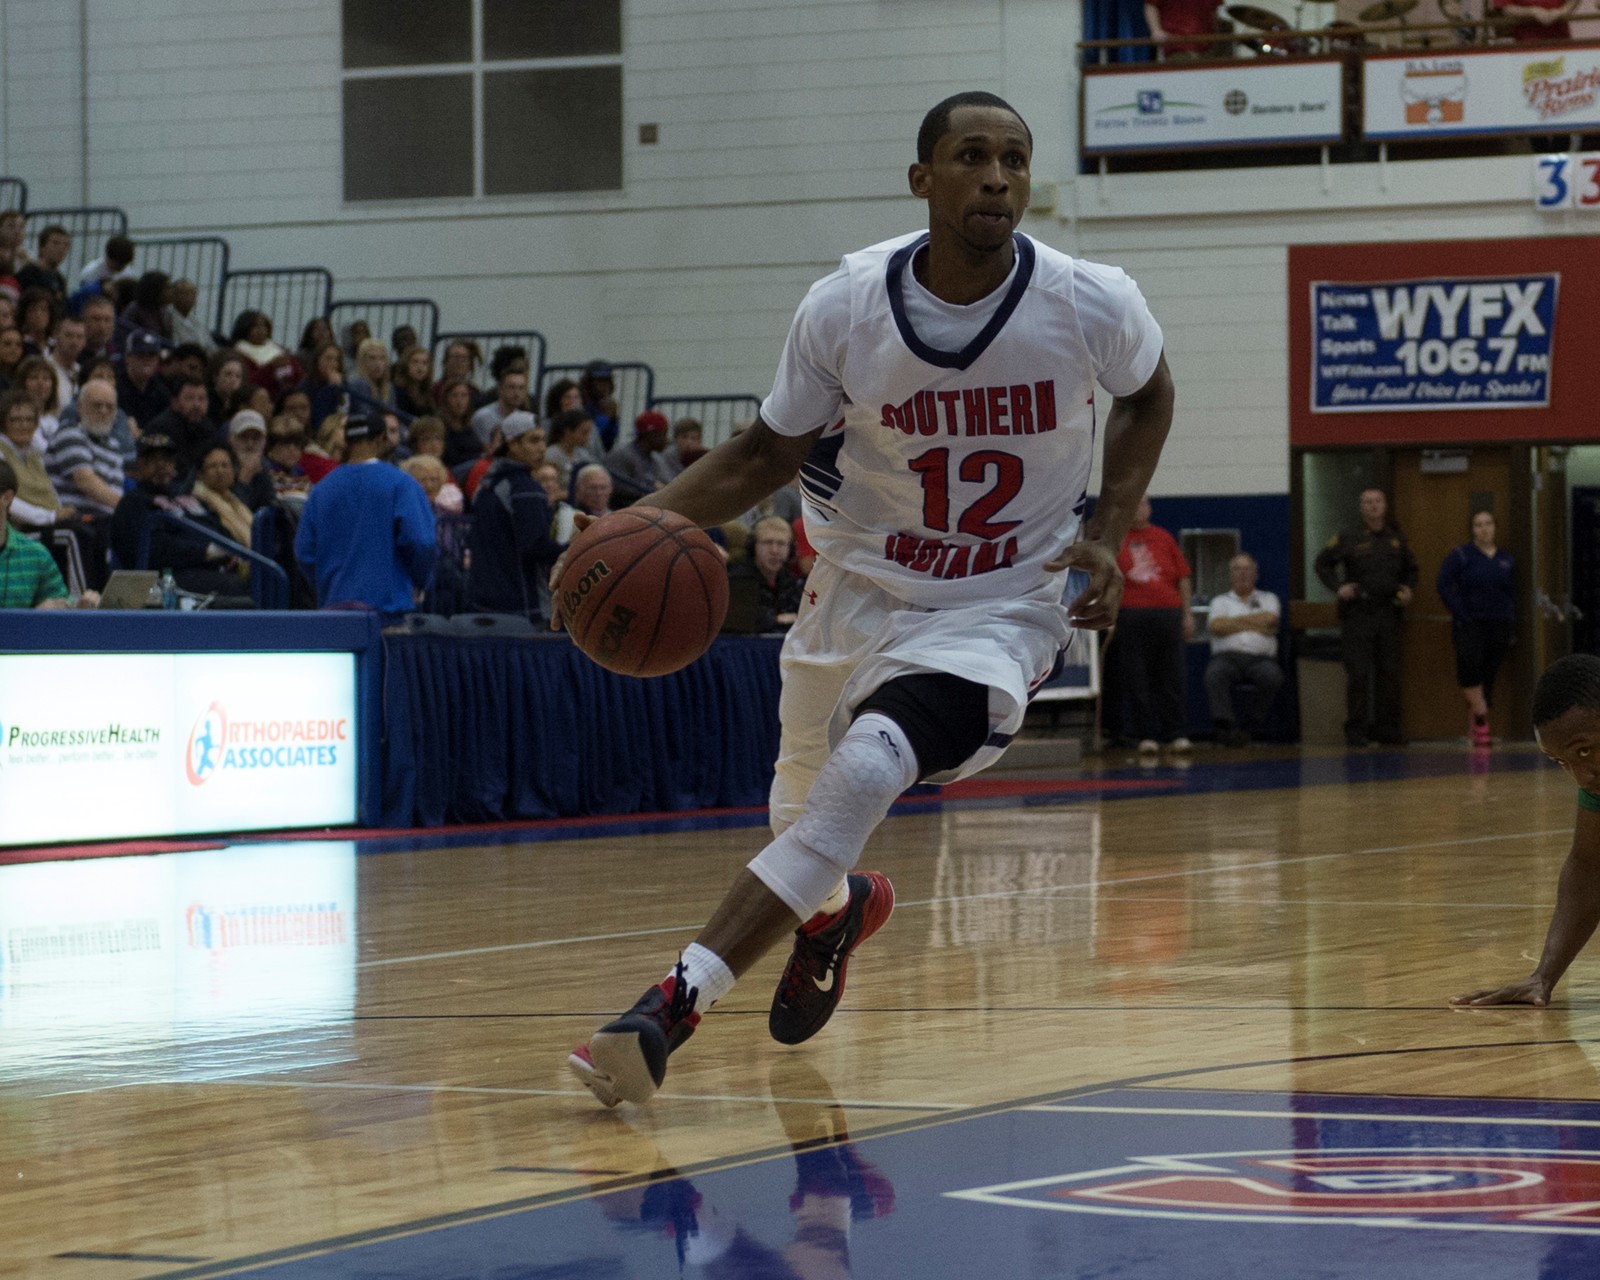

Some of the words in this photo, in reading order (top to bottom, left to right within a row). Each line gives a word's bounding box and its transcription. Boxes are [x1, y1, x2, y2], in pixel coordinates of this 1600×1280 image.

[1538, 158, 1568, 206] 3
[1321, 313, 1357, 331] Talk
[1370, 281, 1547, 341] WYFX
[1320, 338, 1377, 357] Sports
[1395, 337, 1518, 376] 106.7
[1517, 354, 1548, 372] FM
[880, 379, 1057, 437] SOUTHERN
[1456, 380, 1481, 400] for
[908, 447, 1024, 540] 12
[223, 746, 338, 769] ASSOCIATES
